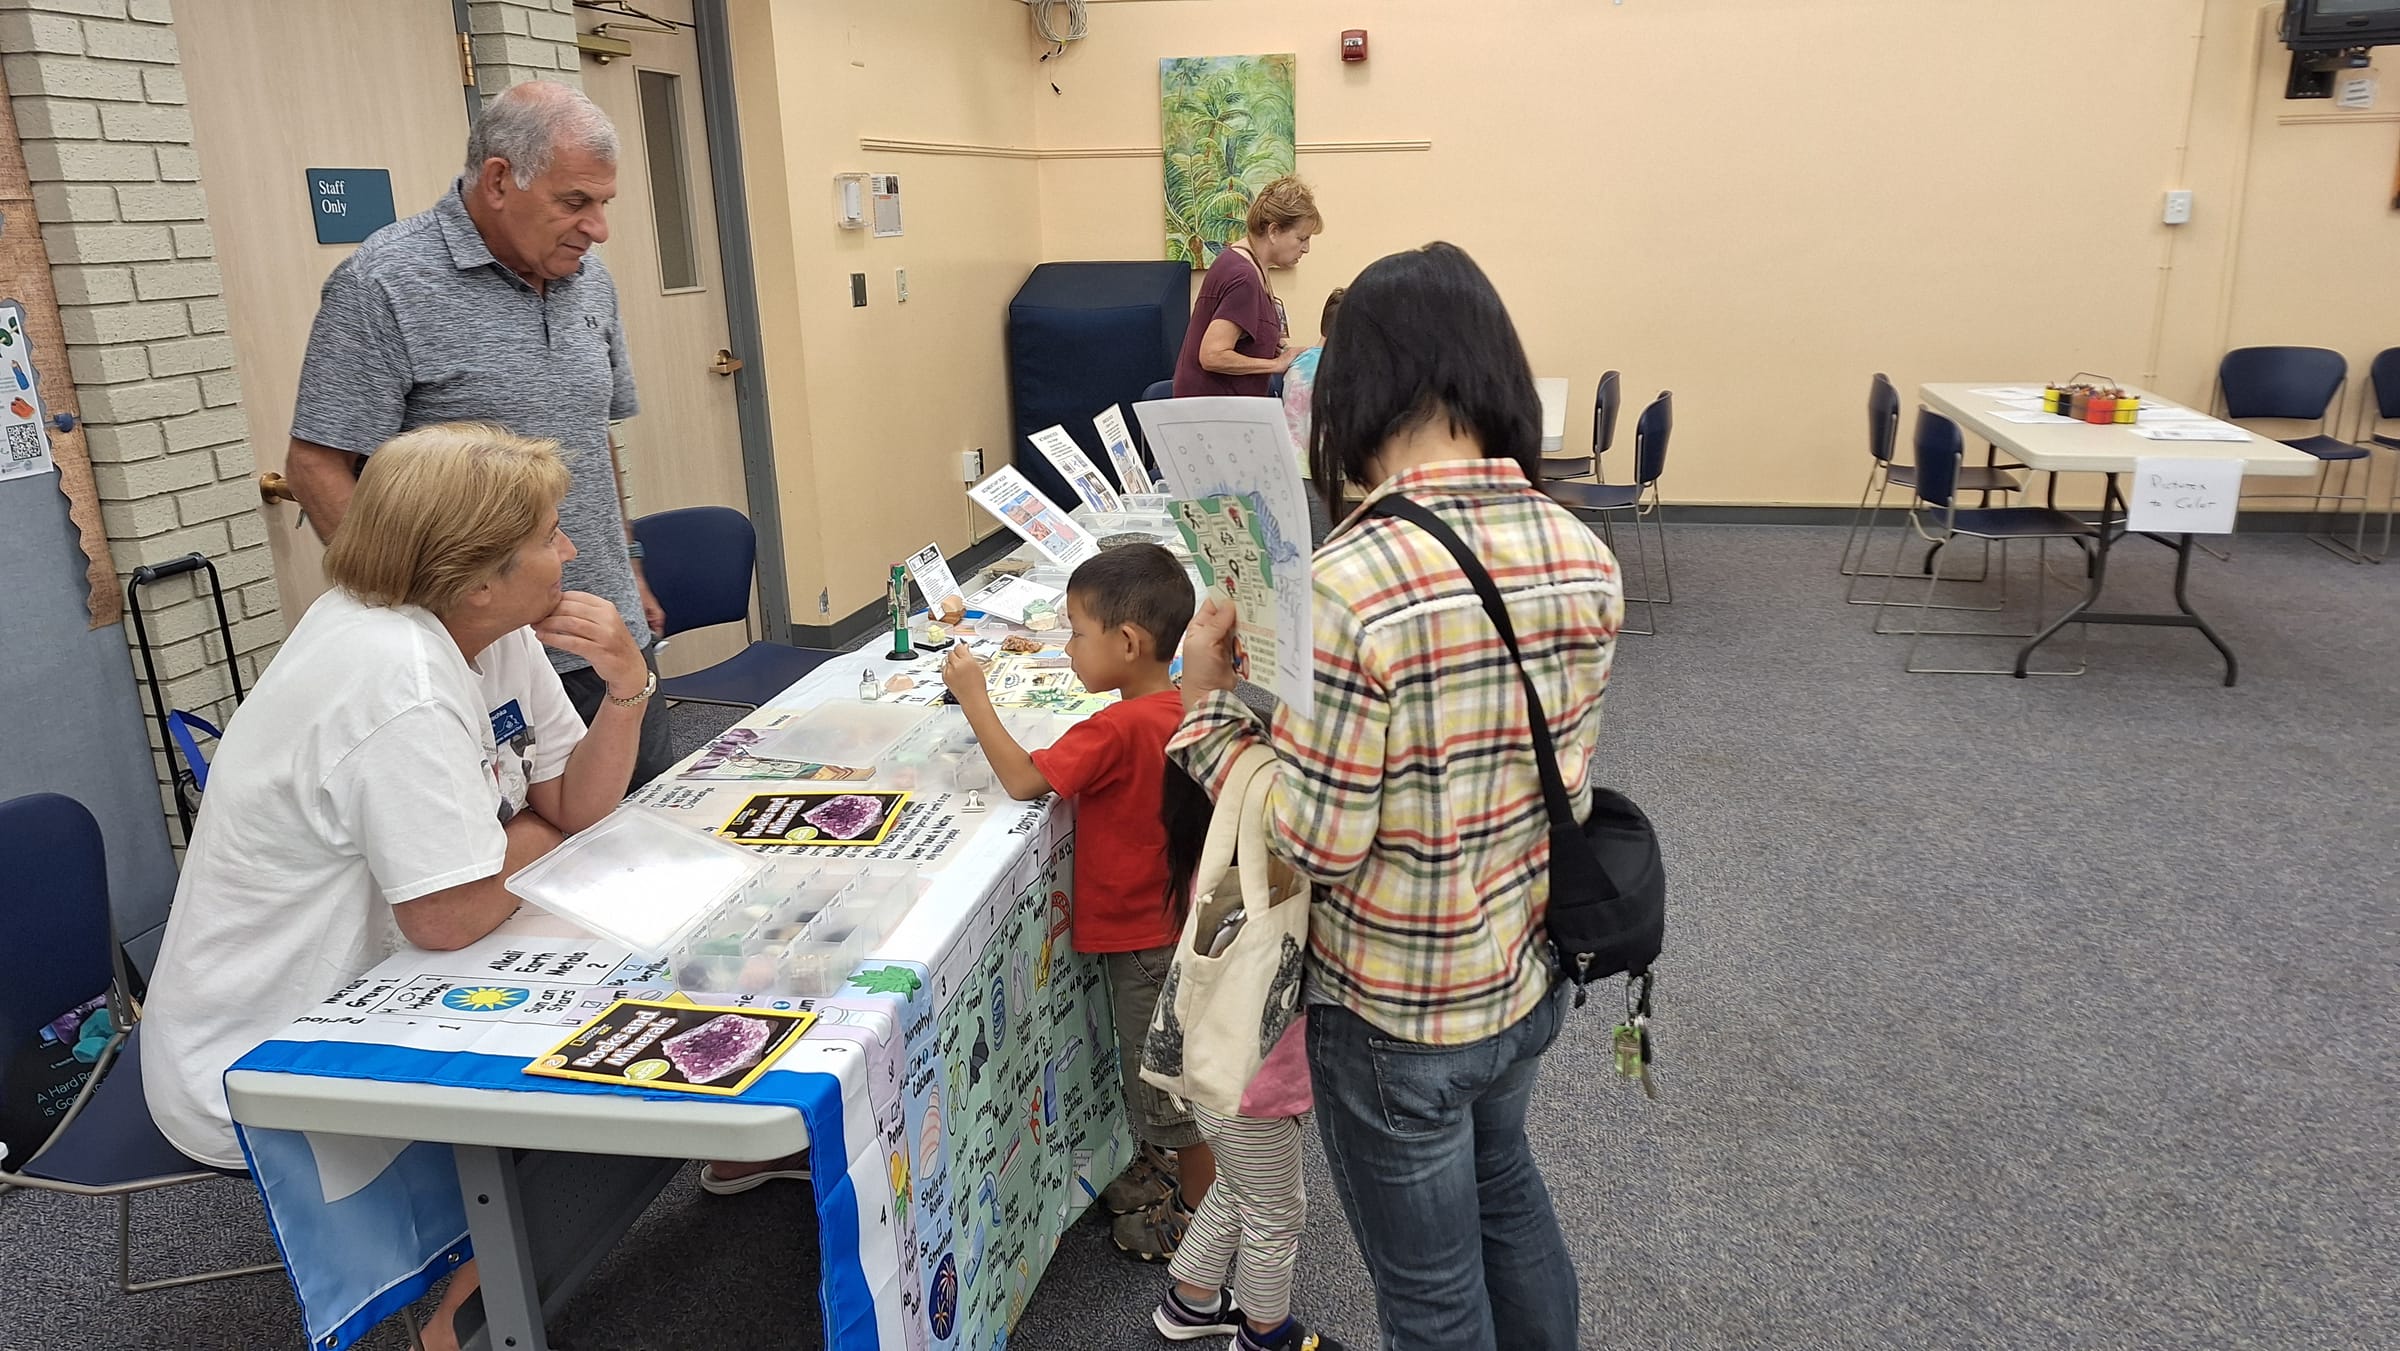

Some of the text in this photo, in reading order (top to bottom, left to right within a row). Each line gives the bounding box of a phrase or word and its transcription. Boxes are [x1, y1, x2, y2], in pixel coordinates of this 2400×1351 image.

[319, 180, 345, 195] Staff
[322, 199, 347, 217] Only
[742, 813, 776, 837] Rocks
[765, 797, 790, 813] and
[765, 799, 806, 834] Minerals
[488, 950, 526, 971] Alkali
[514, 952, 557, 973] Earth
[545, 952, 589, 977] Metals
[547, 989, 577, 1012] Stars
[292, 1016, 366, 1025] Period
[571, 1033, 632, 1067] Rocks
[620, 1010, 661, 1034] and
[604, 1017, 679, 1067] Minerals
[36, 1093, 48, 1104] A
[48, 1077, 79, 1098] Hard
[43, 1106, 55, 1117] is
[880, 1205, 887, 1226] 4
